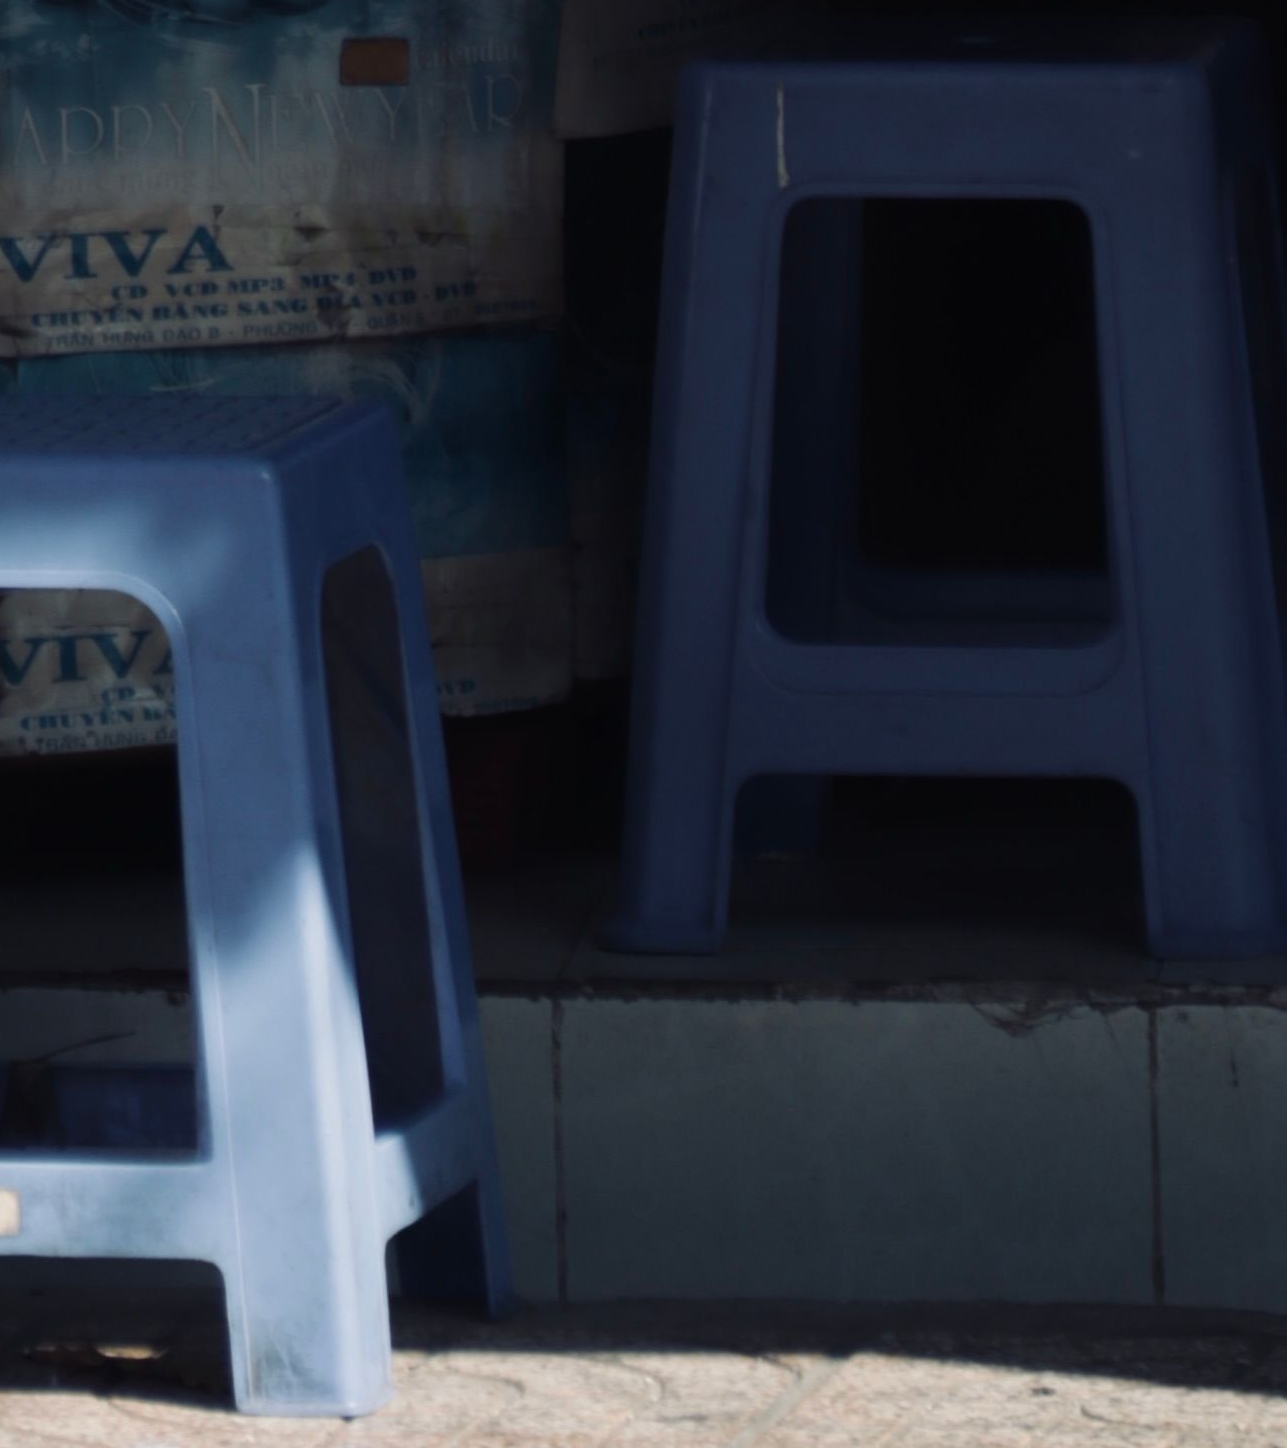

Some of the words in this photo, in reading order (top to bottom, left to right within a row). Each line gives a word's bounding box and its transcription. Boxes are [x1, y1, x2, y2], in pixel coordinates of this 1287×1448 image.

[110, 283, 148, 302] CD
[165, 280, 221, 298] VCD
[228, 277, 285, 296] MP3
[237, 296, 309, 316] SANG
